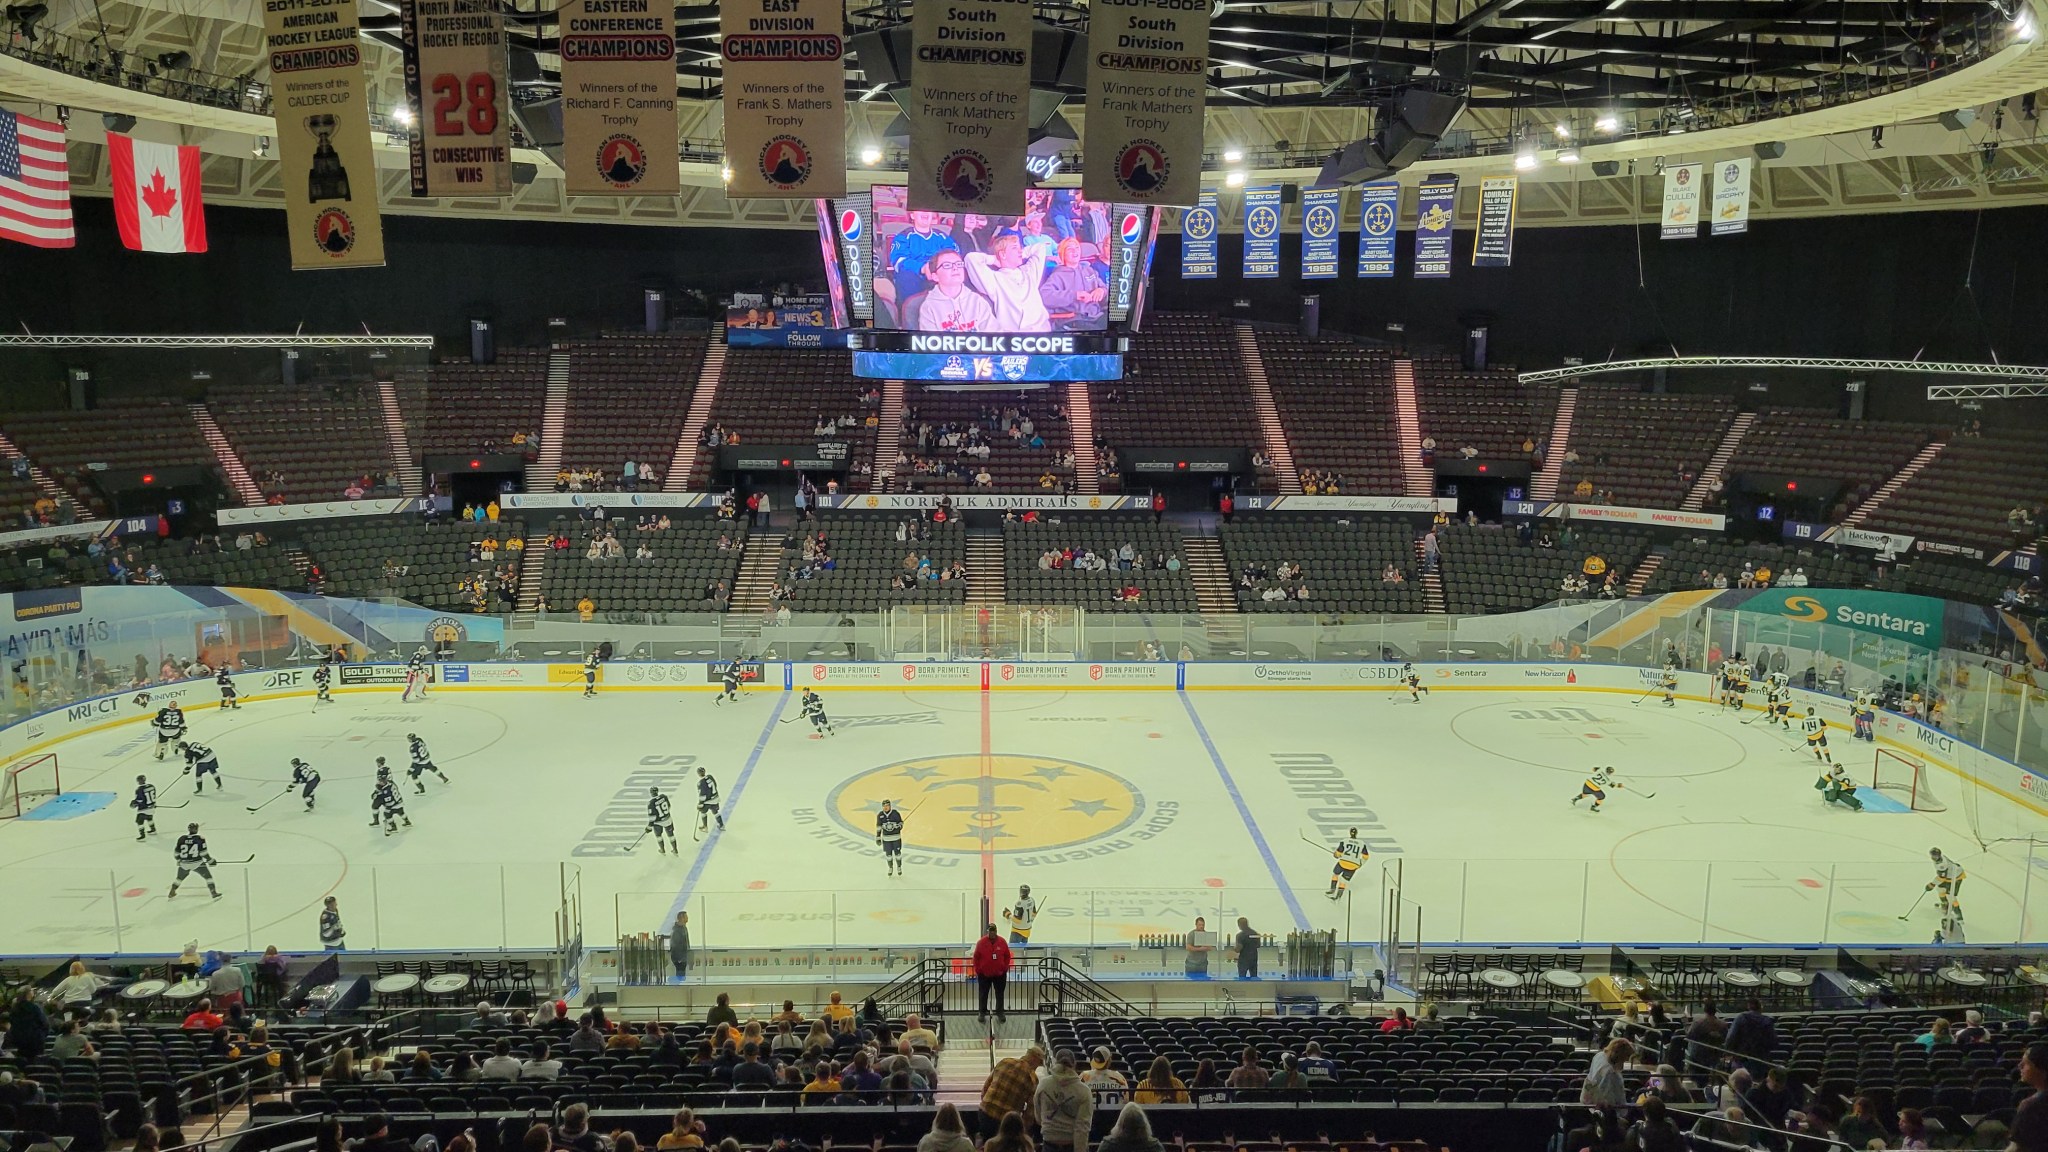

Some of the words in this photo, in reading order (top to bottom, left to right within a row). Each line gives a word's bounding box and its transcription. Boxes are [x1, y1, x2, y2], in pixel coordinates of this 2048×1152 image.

[267, 0, 350, 11] 2011-20
[419, 1, 449, 15] NORTH
[454, 0, 500, 14] AMERICAN
[584, 0, 648, 13] EASTERN
[762, 0, 798, 12] EAST
[283, 12, 338, 28] AMERICAN
[948, 7, 997, 22] South
[427, 16, 493, 31] PROFESSIONAL
[570, 18, 663, 31] CONFERENCE
[750, 18, 814, 30] DIVISION
[1128, 16, 1176, 31] South
[268, 32, 311, 47] HOCKEY
[315, 27, 357, 42] LEAGUE
[423, 34, 459, 48] HOCKEY
[463, 32, 499, 46] RECORD
[938, 26, 1006, 41] Division
[565, 39, 670, 57] CHAMPIONS
[727, 39, 837, 57] CHAMPIONS
[1118, 34, 1184, 51] Division
[272, 47, 358, 70] CHAMPIONS
[918, 47, 1026, 64] CHAMPIONS
[1098, 54, 1202, 72] CHAMPIONS
[408, 64, 417, 85] 10
[286, 82, 323, 91] Winners
[325, 80, 334, 88] of
[336, 80, 349, 88] the
[580, 83, 624, 93] Winners
[627, 83, 639, 93] of
[641, 83, 657, 93] the
[742, 83, 789, 93] Winners
[792, 83, 804, 93] of
[806, 83, 825, 93] the
[1102, 82, 1154, 97] Winners
[1158, 84, 1171, 97] of
[1174, 86, 1196, 98] the
[288, 96, 328, 107] CALDER
[330, 92, 350, 104] CUP
[923, 87, 976, 101] Winners
[980, 90, 993, 102] of
[996, 91, 1018, 104] the
[432, 72, 497, 136] 28
[566, 98, 610, 109] Richard
[613, 99, 623, 109] F.
[626, 98, 673, 112] Canning
[737, 98, 769, 110] Frank
[772, 99, 784, 110] S.
[787, 98, 832, 110] Mathers
[1103, 98, 1138, 112] Frank
[1142, 101, 1193, 114] Mathers
[923, 104, 960, 118] Frank
[964, 106, 1015, 120] Mathers
[601, 114, 639, 127] Trophy
[765, 115, 803, 128] Trophy
[1124, 117, 1169, 132] Trophy
[946, 122, 992, 138] Trophy
[433, 147, 504, 163] CONSECUTIVE
[456, 168, 483, 183] WINS
[1484, 190, 1512, 198] ADMIRALS
[1666, 193, 1697, 201] CULLEN
[1716, 191, 1745, 200] BROPHY
[846, 244, 866, 307] pepsi
[1187, 265, 1212, 273] 1991
[1117, 247, 1134, 309] pepsi
[785, 312, 811, 322] NEWS
[810, 310, 824, 327] 3
[911, 335, 1006, 352] NORFOLK
[1010, 336, 1073, 352] SCOPE
[819, 496, 833, 507] 101
[891, 496, 977, 507] NORFLK
[986, 497, 1078, 507] ADMIRALS
[1134, 498, 1149, 508] 122
[1249, 498, 1262, 508] 121
[1387, 499, 1431, 511] Yuengling
[1518, 504, 1533, 514] 120
[1578, 508, 1603, 517] FAMILY
[1652, 513, 1677, 522] FAMILY
[127, 519, 146, 532] 104
[1795, 524, 1811, 537] 119
[1849, 531, 1892, 543] Hackwoh
[2014, 556, 2030, 570] 118
[17, 607, 43, 617] CORONA
[44, 603, 65, 613] PARTY
[66, 602, 80, 610] PAD
[1836, 606, 1927, 636] Sentara
[68, 617, 109, 645] MÁS
[345, 667, 372, 676] SOLID
[1268, 669, 1311, 677] OrthoVirginia
[1454, 669, 1487, 677] Sentara
[1639, 669, 1666, 680] Natura
[163, 715, 179, 725] 32
[1806, 721, 1816, 732] 14
[656, 801, 670, 817] 19
[1130, 801, 1180, 841] SCOPE
[180, 844, 198, 858] 24
[1014, 839, 1134, 866] ARENA
[1344, 843, 1360, 858] 24
